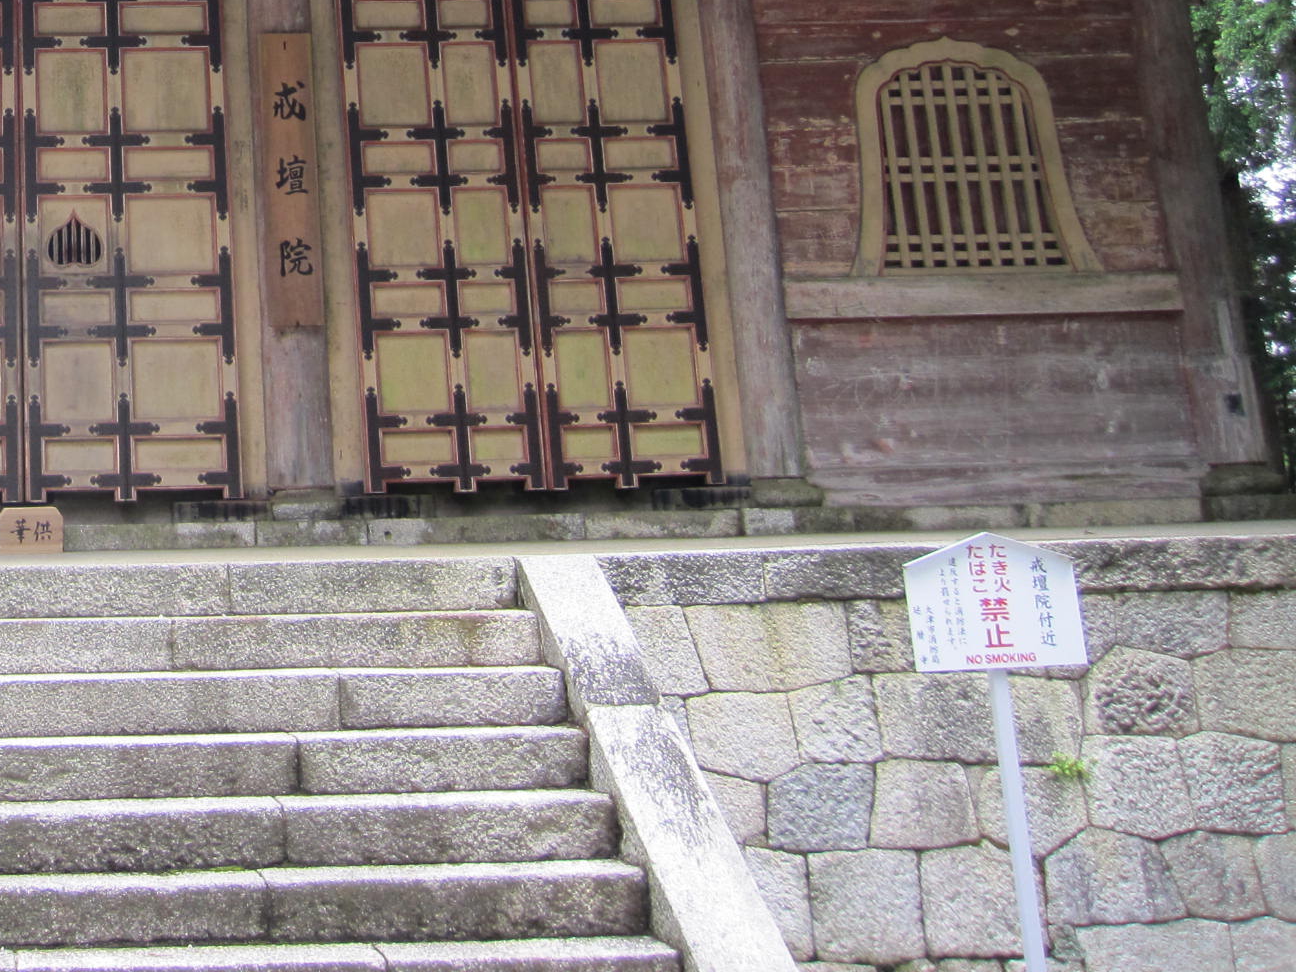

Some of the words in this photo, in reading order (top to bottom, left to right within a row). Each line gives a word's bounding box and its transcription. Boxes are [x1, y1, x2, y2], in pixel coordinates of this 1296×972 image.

[273, 80, 313, 277] 戒壇院
[989, 543, 1012, 593] たき火
[979, 597, 1015, 648] 禁止
[1030, 556, 1057, 647] 戒壇院付近
[966, 654, 983, 665] NO
[985, 652, 1037, 664] SMOKING
